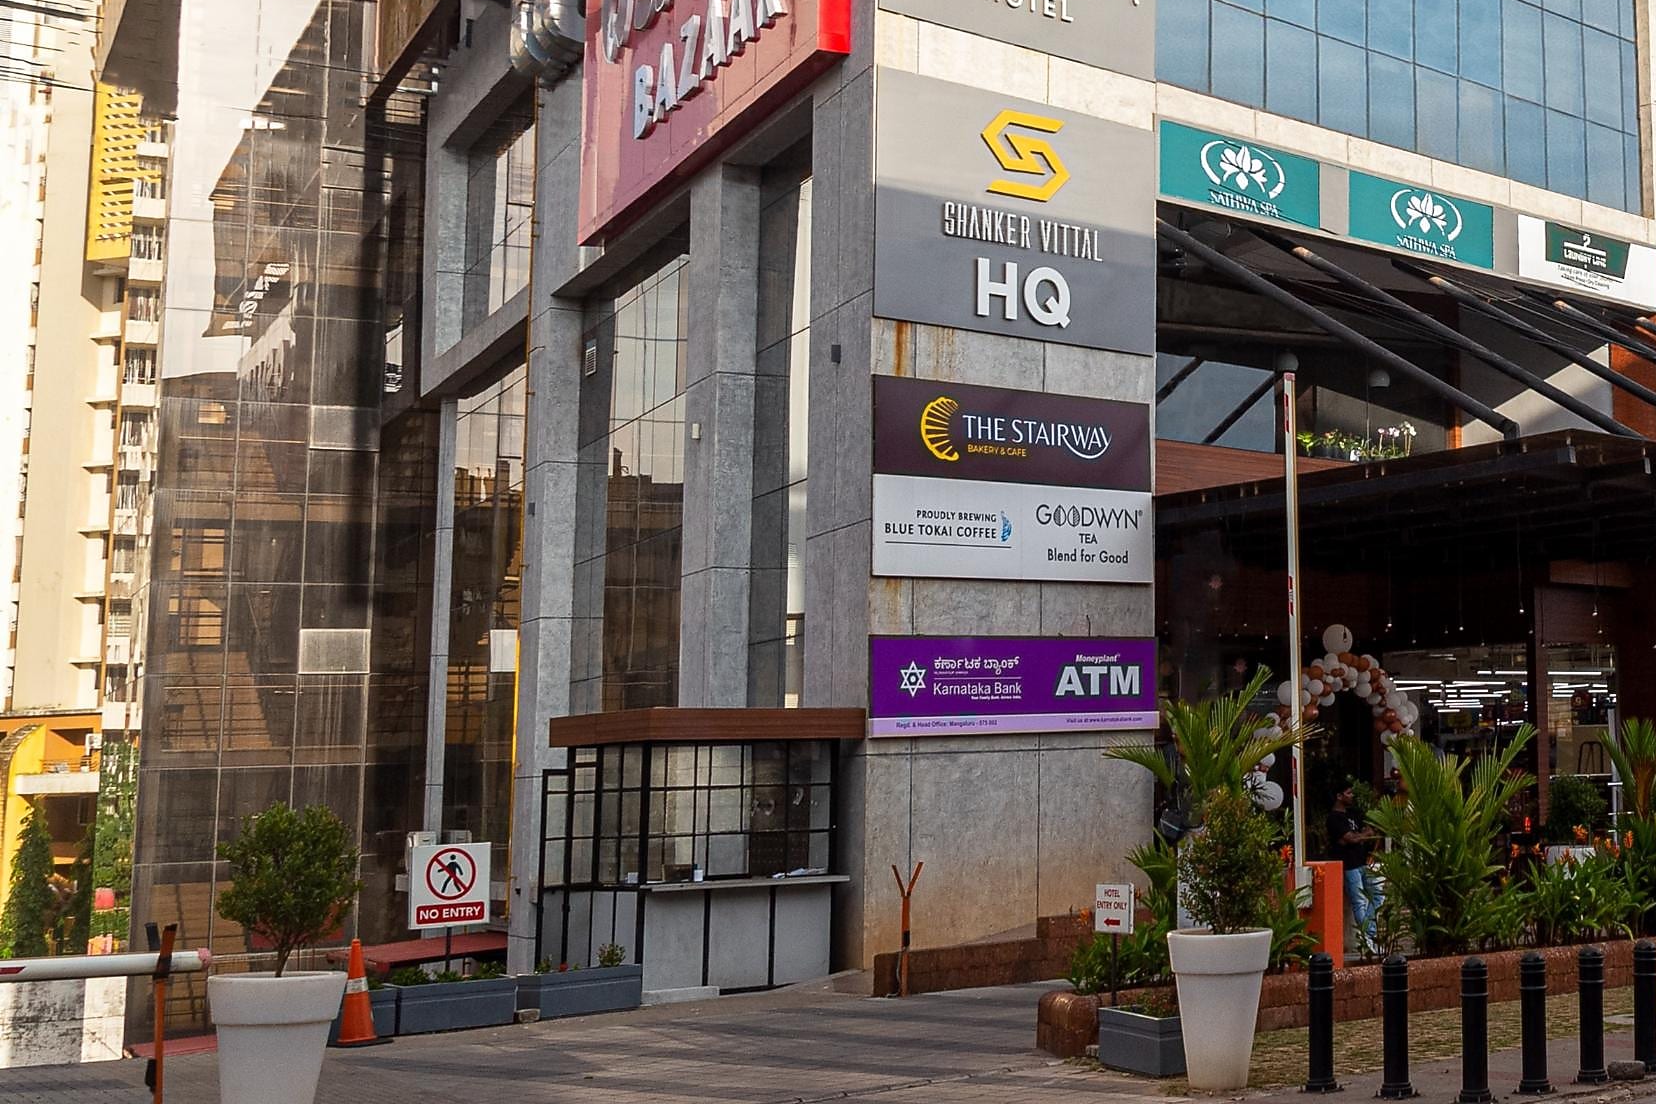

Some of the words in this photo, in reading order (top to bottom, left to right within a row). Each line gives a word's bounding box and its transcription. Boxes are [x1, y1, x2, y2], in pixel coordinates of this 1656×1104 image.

[1209, 190, 1259, 214] SATHWA
[1260, 201, 1280, 218] SPA
[943, 200, 1031, 249] SHANKER
[1040, 219, 1103, 262] VITTAL
[1439, 243, 1457, 259] SPA
[976, 257, 1072, 329] HQ
[962, 414, 1006, 442] THE
[1012, 419, 1113, 459] STAIRWAY
[967, 443, 999, 455] BAKERY
[999, 447, 1006, 455] &
[1007, 447, 1027, 458] CAFE
[916, 509, 957, 521] PROUDLY
[958, 511, 997, 523] BREWING
[884, 522, 914, 536] BLUE
[918, 523, 953, 537] TOKAI
[956, 526, 997, 539] COFFEE
[1078, 533, 1098, 545] TEA
[1047, 548, 1077, 563] Blend
[1080, 549, 1097, 563] for
[1099, 550, 1129, 564] Good
[1055, 665, 1140, 696] ATM
[933, 682, 991, 696] Karnataka
[994, 682, 1021, 695] Bank
[1104, 888, 1120, 898] HOTEL
[419, 908, 439, 921] NO
[442, 906, 481, 919] ENTRY
[1096, 900, 1113, 910] ENTRY
[1113, 900, 1128, 911] ONLY
